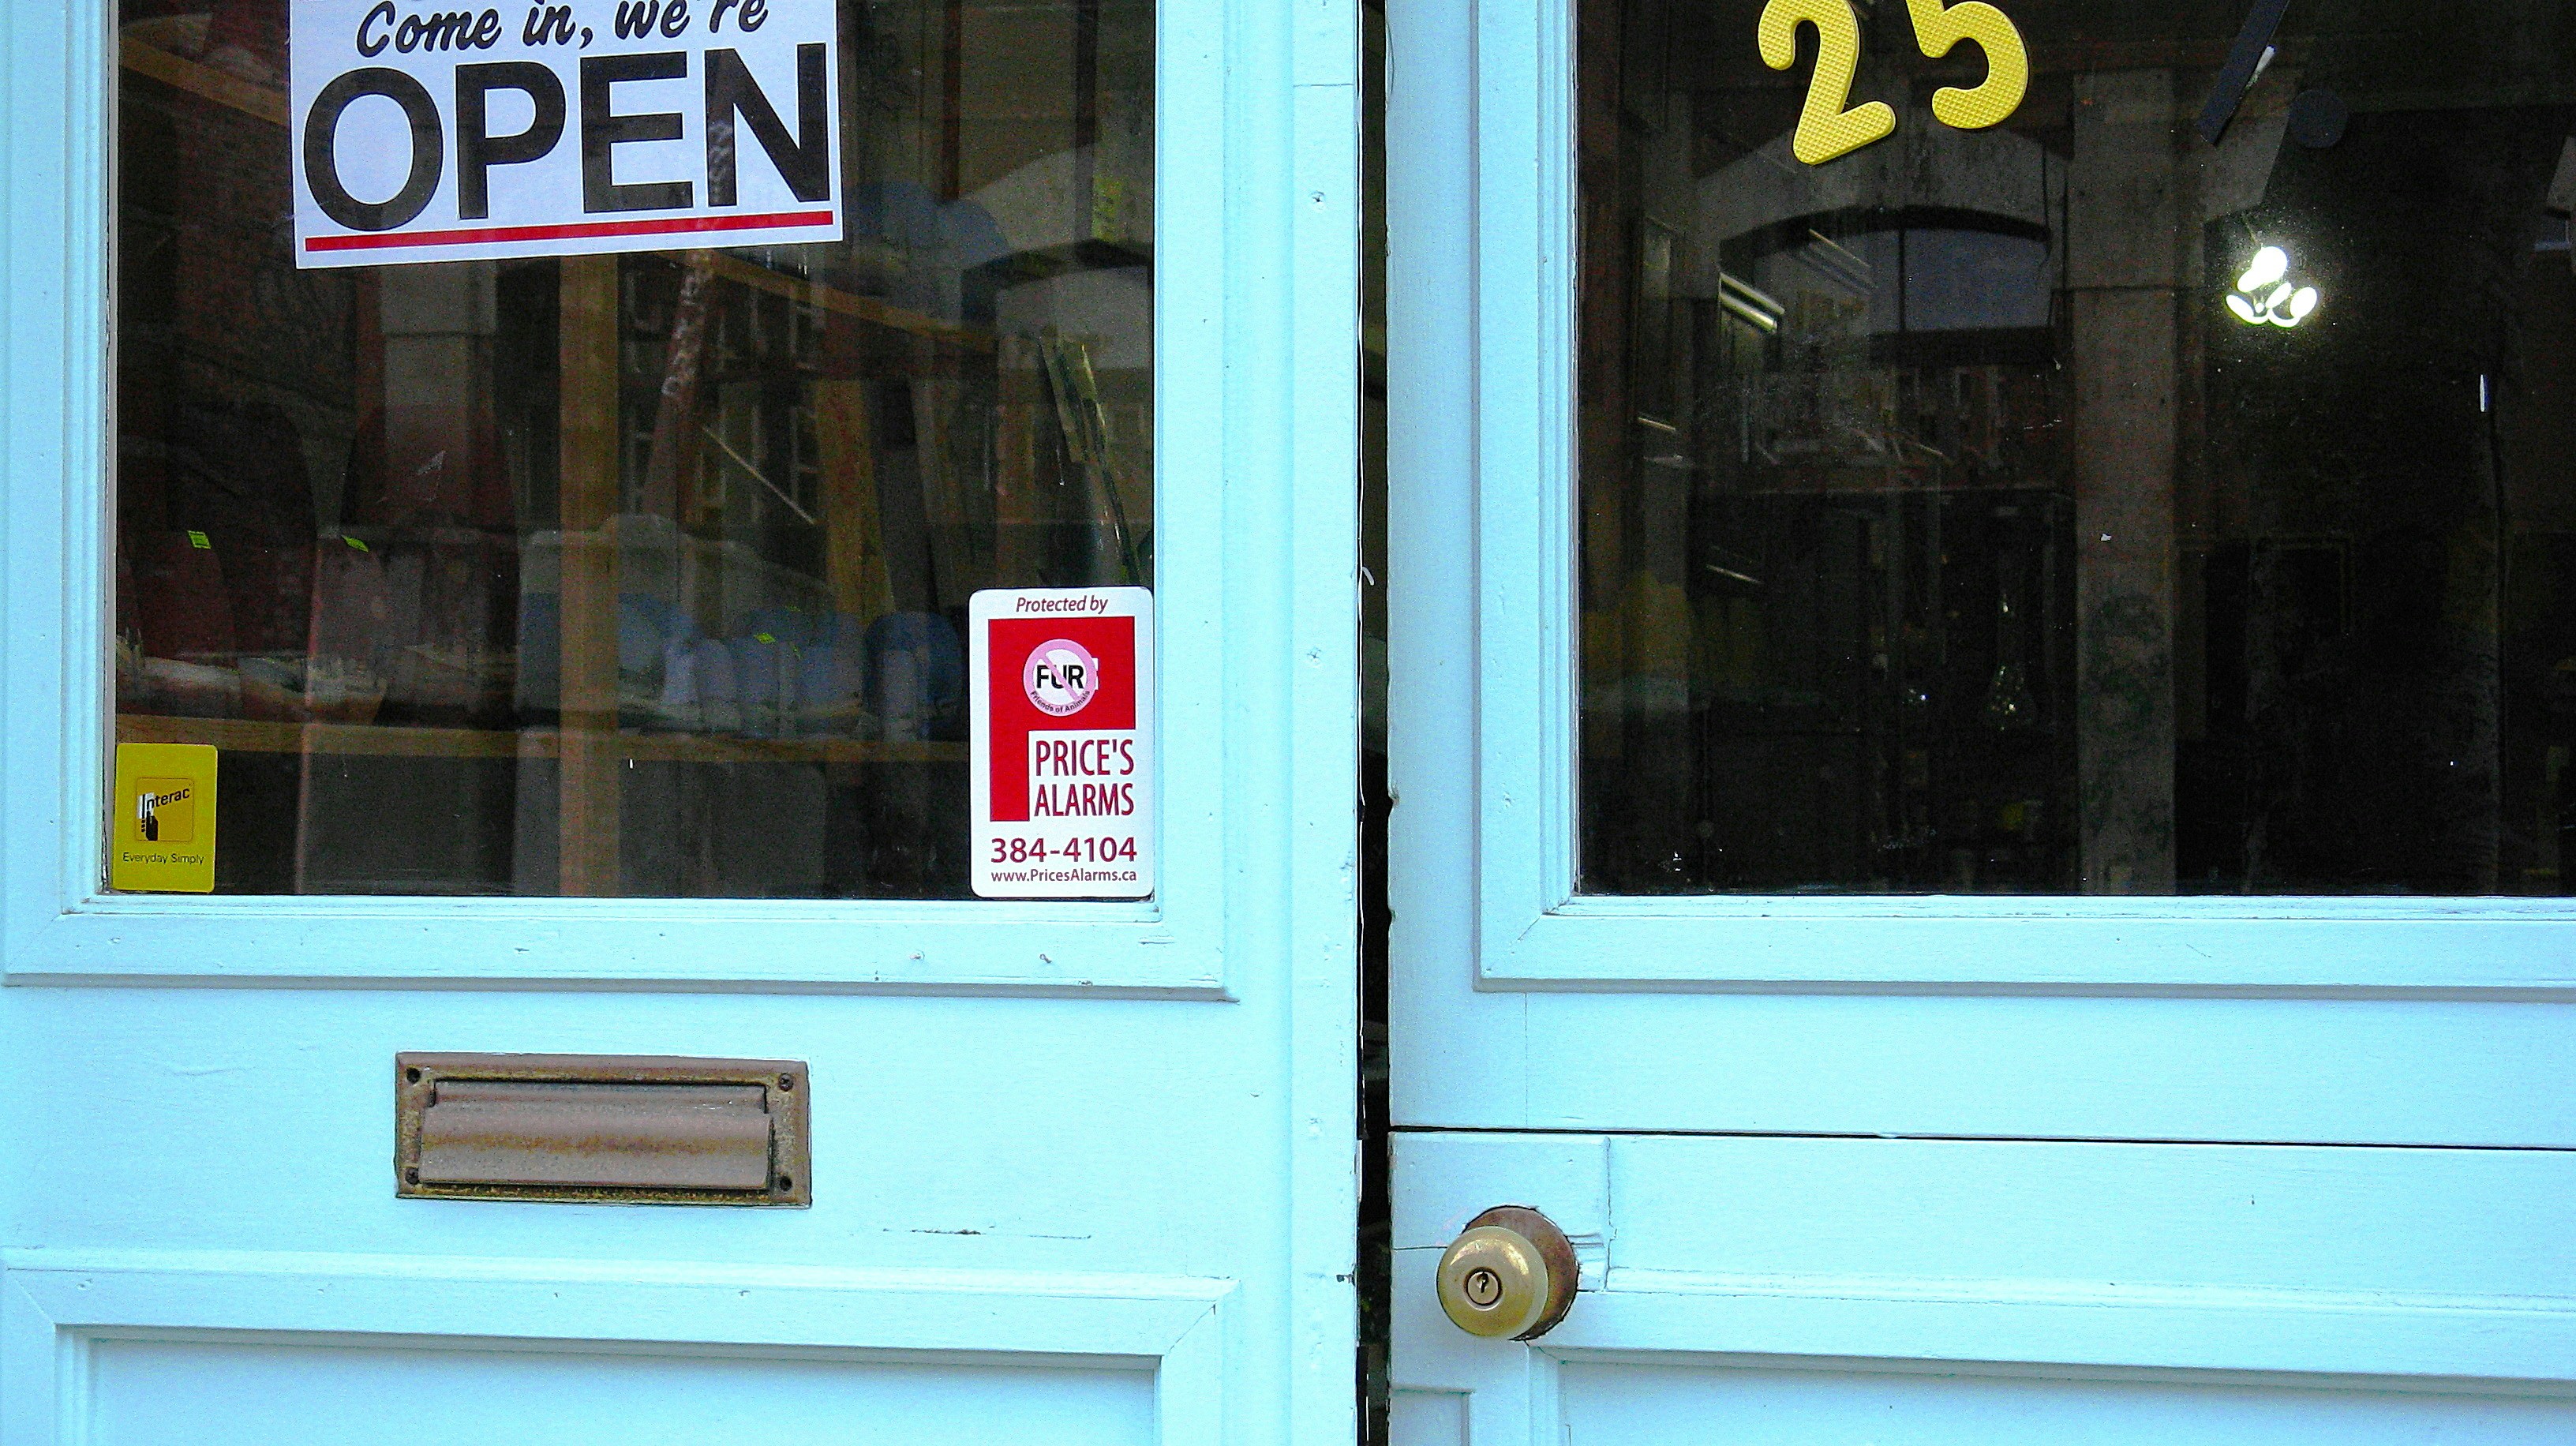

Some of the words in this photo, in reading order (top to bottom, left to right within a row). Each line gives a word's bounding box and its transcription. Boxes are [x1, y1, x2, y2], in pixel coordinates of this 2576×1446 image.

[357, 1, 503, 58] Come
[522, 0, 593, 49] in,
[303, 42, 831, 232] OPEN
[1016, 596, 1086, 612] Protected
[1090, 595, 1109, 615] by
[1036, 665, 1084, 689] FUR
[1031, 690, 1054, 712] Friends
[1065, 690, 1091, 712] Animals
[1035, 739, 1135, 777] PRICE'S
[142, 788, 190, 819] Interac
[1034, 782, 1134, 817] ALARMS
[122, 852, 168, 864] Everyday
[170, 853, 204, 865] Simply
[990, 837, 1137, 863] 384-4104
[990, 867, 1137, 882] www.PricesAlarms.ca
